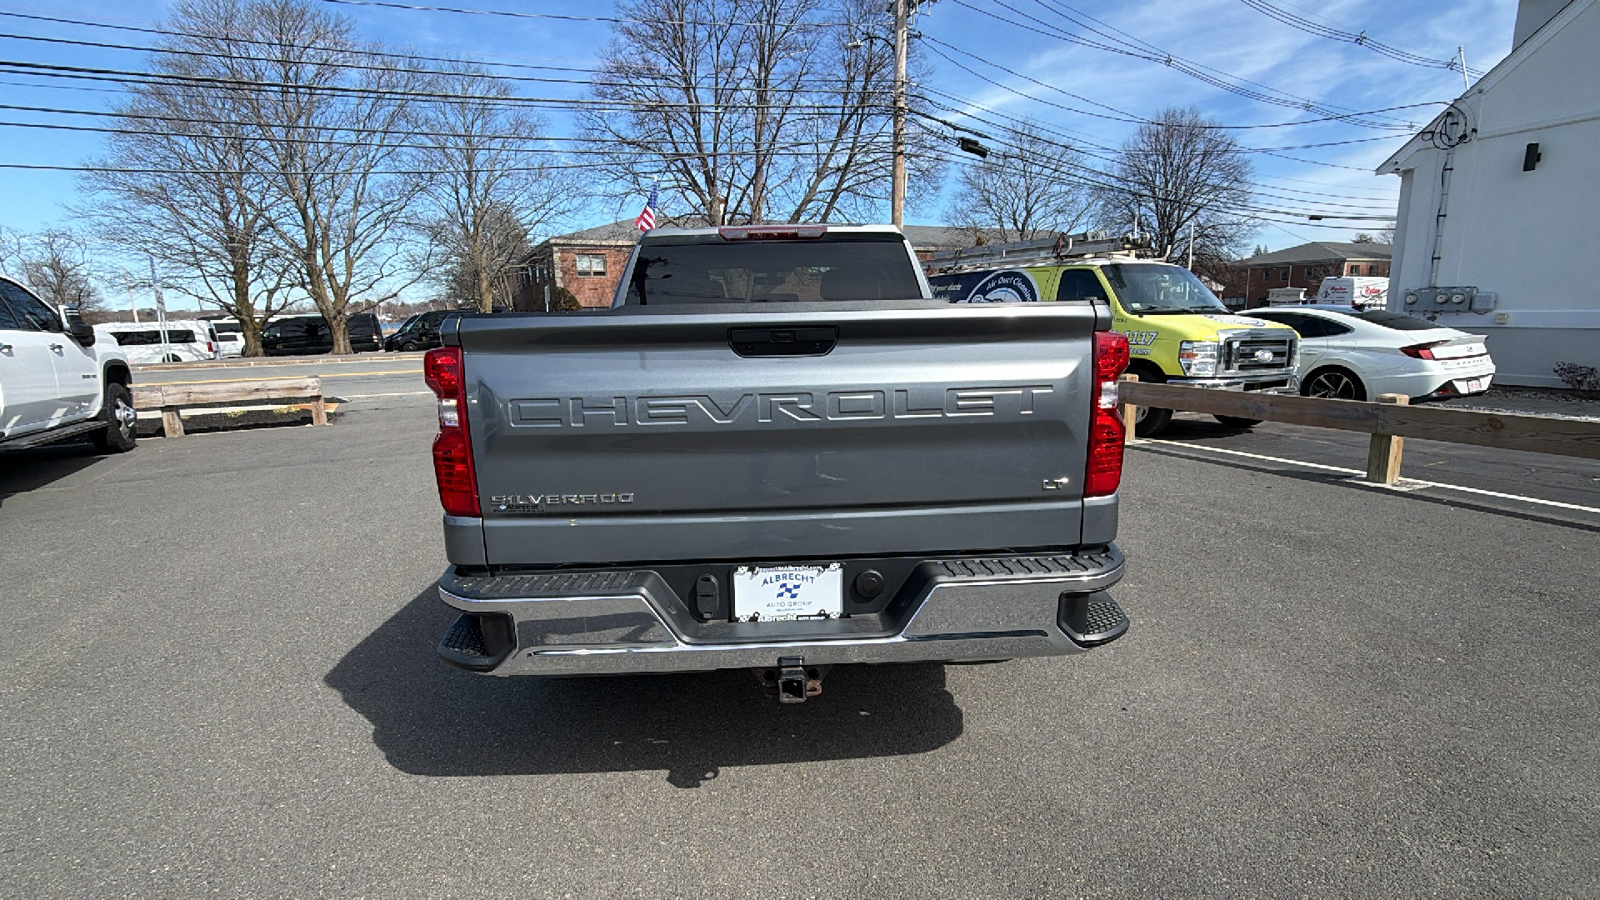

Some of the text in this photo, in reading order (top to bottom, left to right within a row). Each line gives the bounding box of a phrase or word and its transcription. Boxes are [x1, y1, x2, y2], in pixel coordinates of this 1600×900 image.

[986, 279, 998, 290] Air
[998, 276, 1014, 284] Duct
[1364, 285, 1381, 294] Ryder
[509, 385, 1054, 428] CHEVROLET
[1042, 478, 1068, 490] LT
[491, 493, 634, 504] SILVERADO
[761, 573, 816, 587] ALBRECHT
[758, 613, 798, 622] Albrecht
